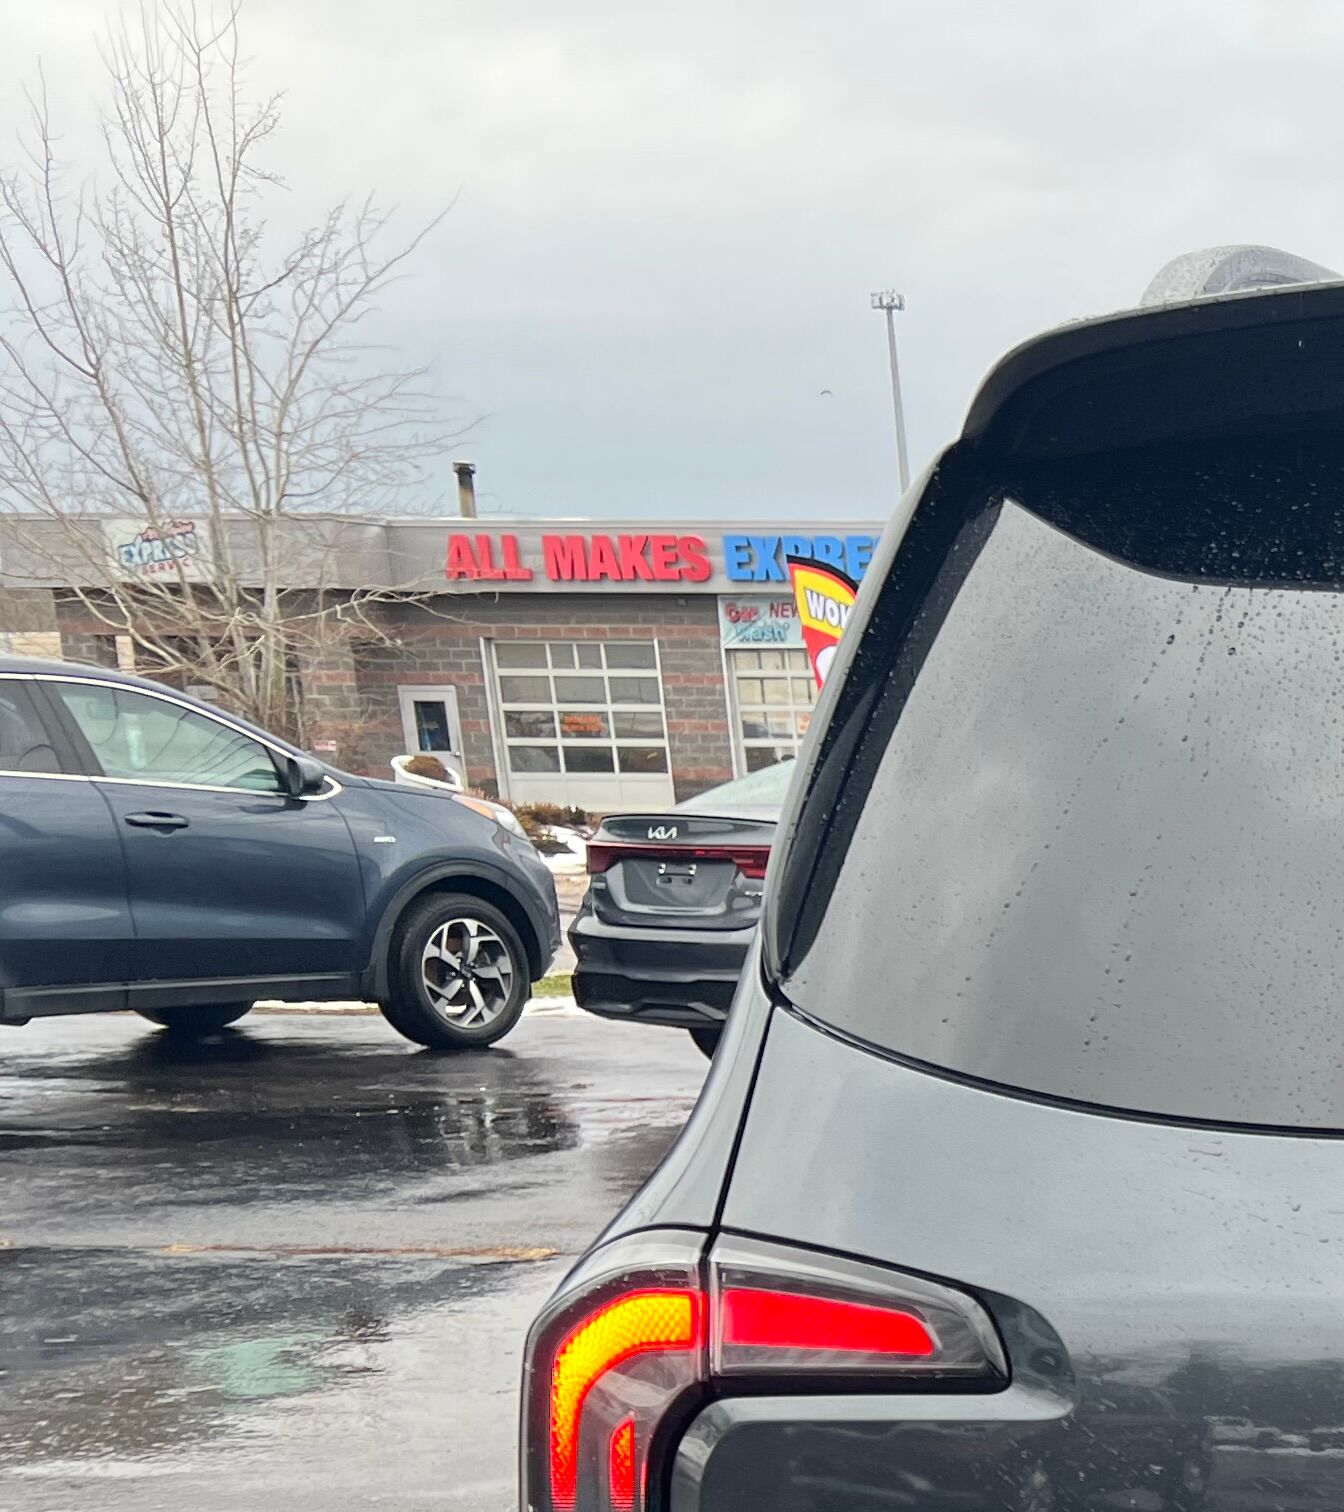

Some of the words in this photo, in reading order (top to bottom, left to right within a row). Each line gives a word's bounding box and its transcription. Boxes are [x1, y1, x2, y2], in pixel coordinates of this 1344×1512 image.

[447, 535, 533, 581] ALL
[542, 535, 712, 582] MAKES
[723, 535, 881, 582] EXPRE
[648, 826, 677, 840] KIA
